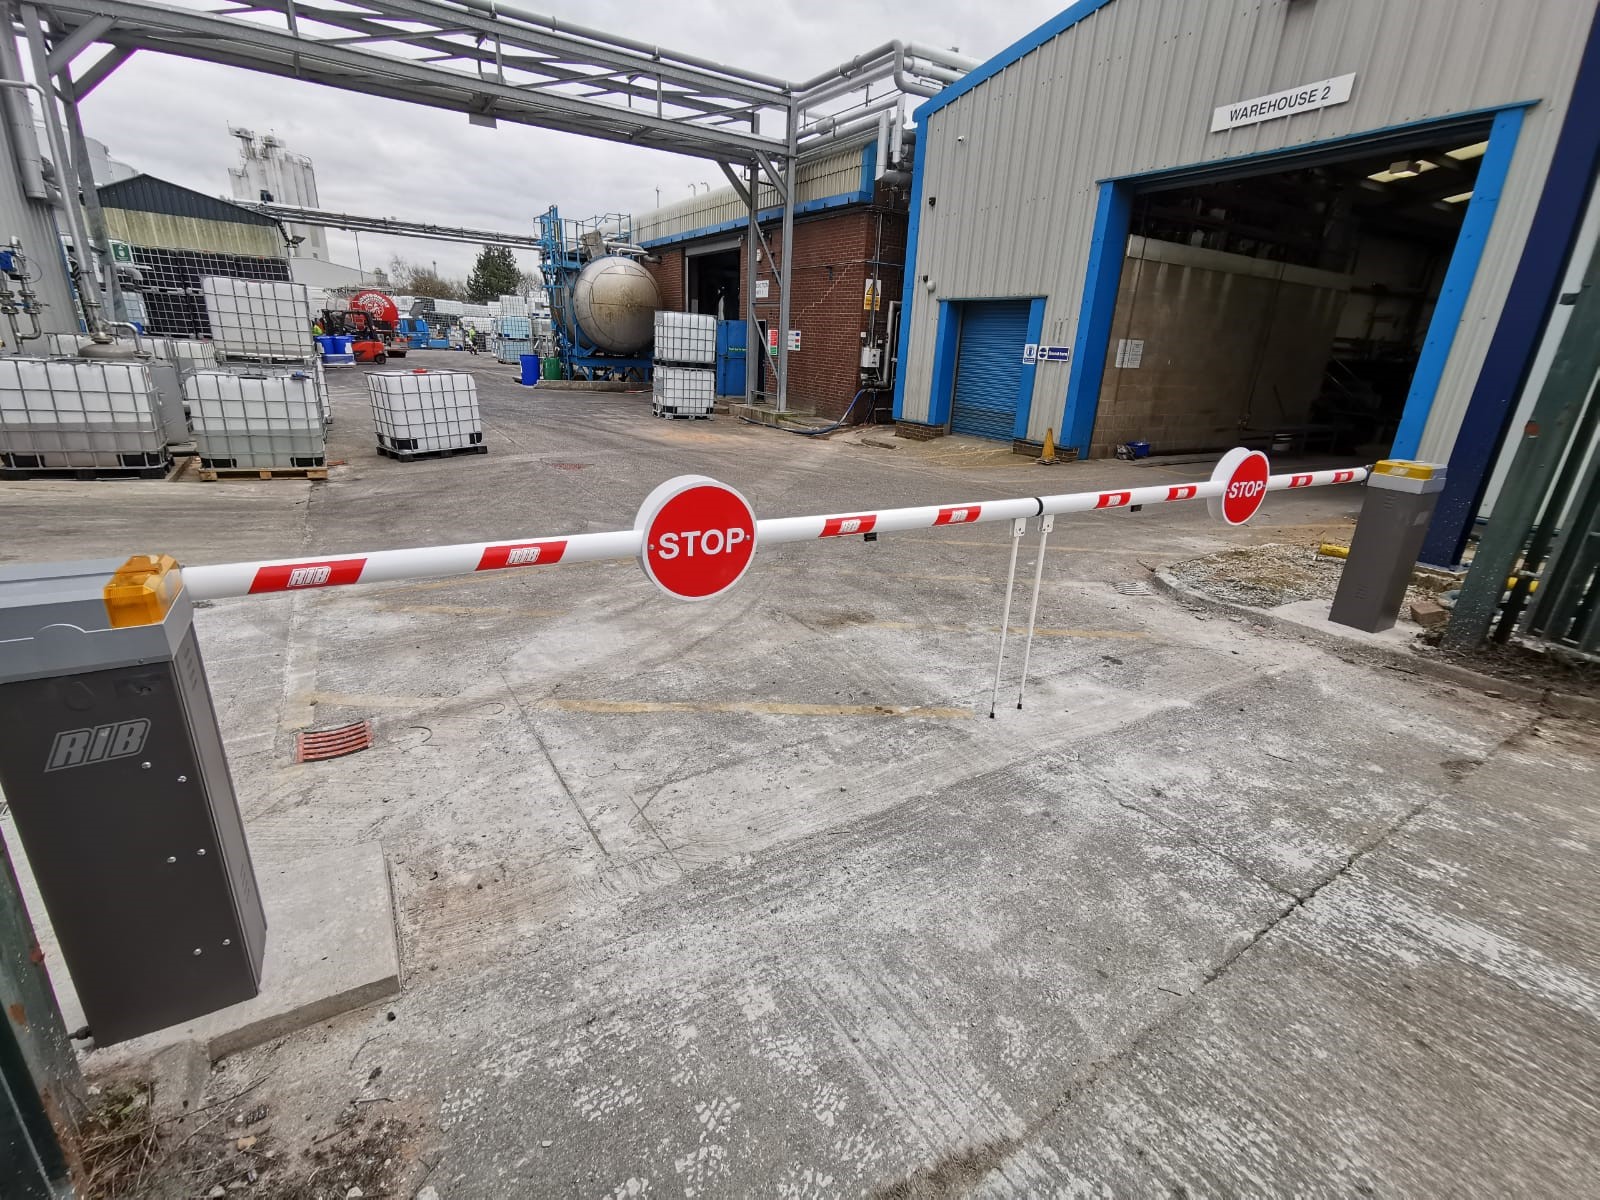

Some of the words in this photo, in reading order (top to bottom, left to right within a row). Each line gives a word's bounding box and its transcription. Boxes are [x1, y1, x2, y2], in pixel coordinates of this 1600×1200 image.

[1230, 88, 1318, 122] WAREHOUSE
[1321, 85, 1332, 100] 2
[1228, 480, 1264, 499] STOP
[658, 527, 745, 560] STOP
[286, 565, 331, 588] RIB
[44, 718, 151, 773] RIB
